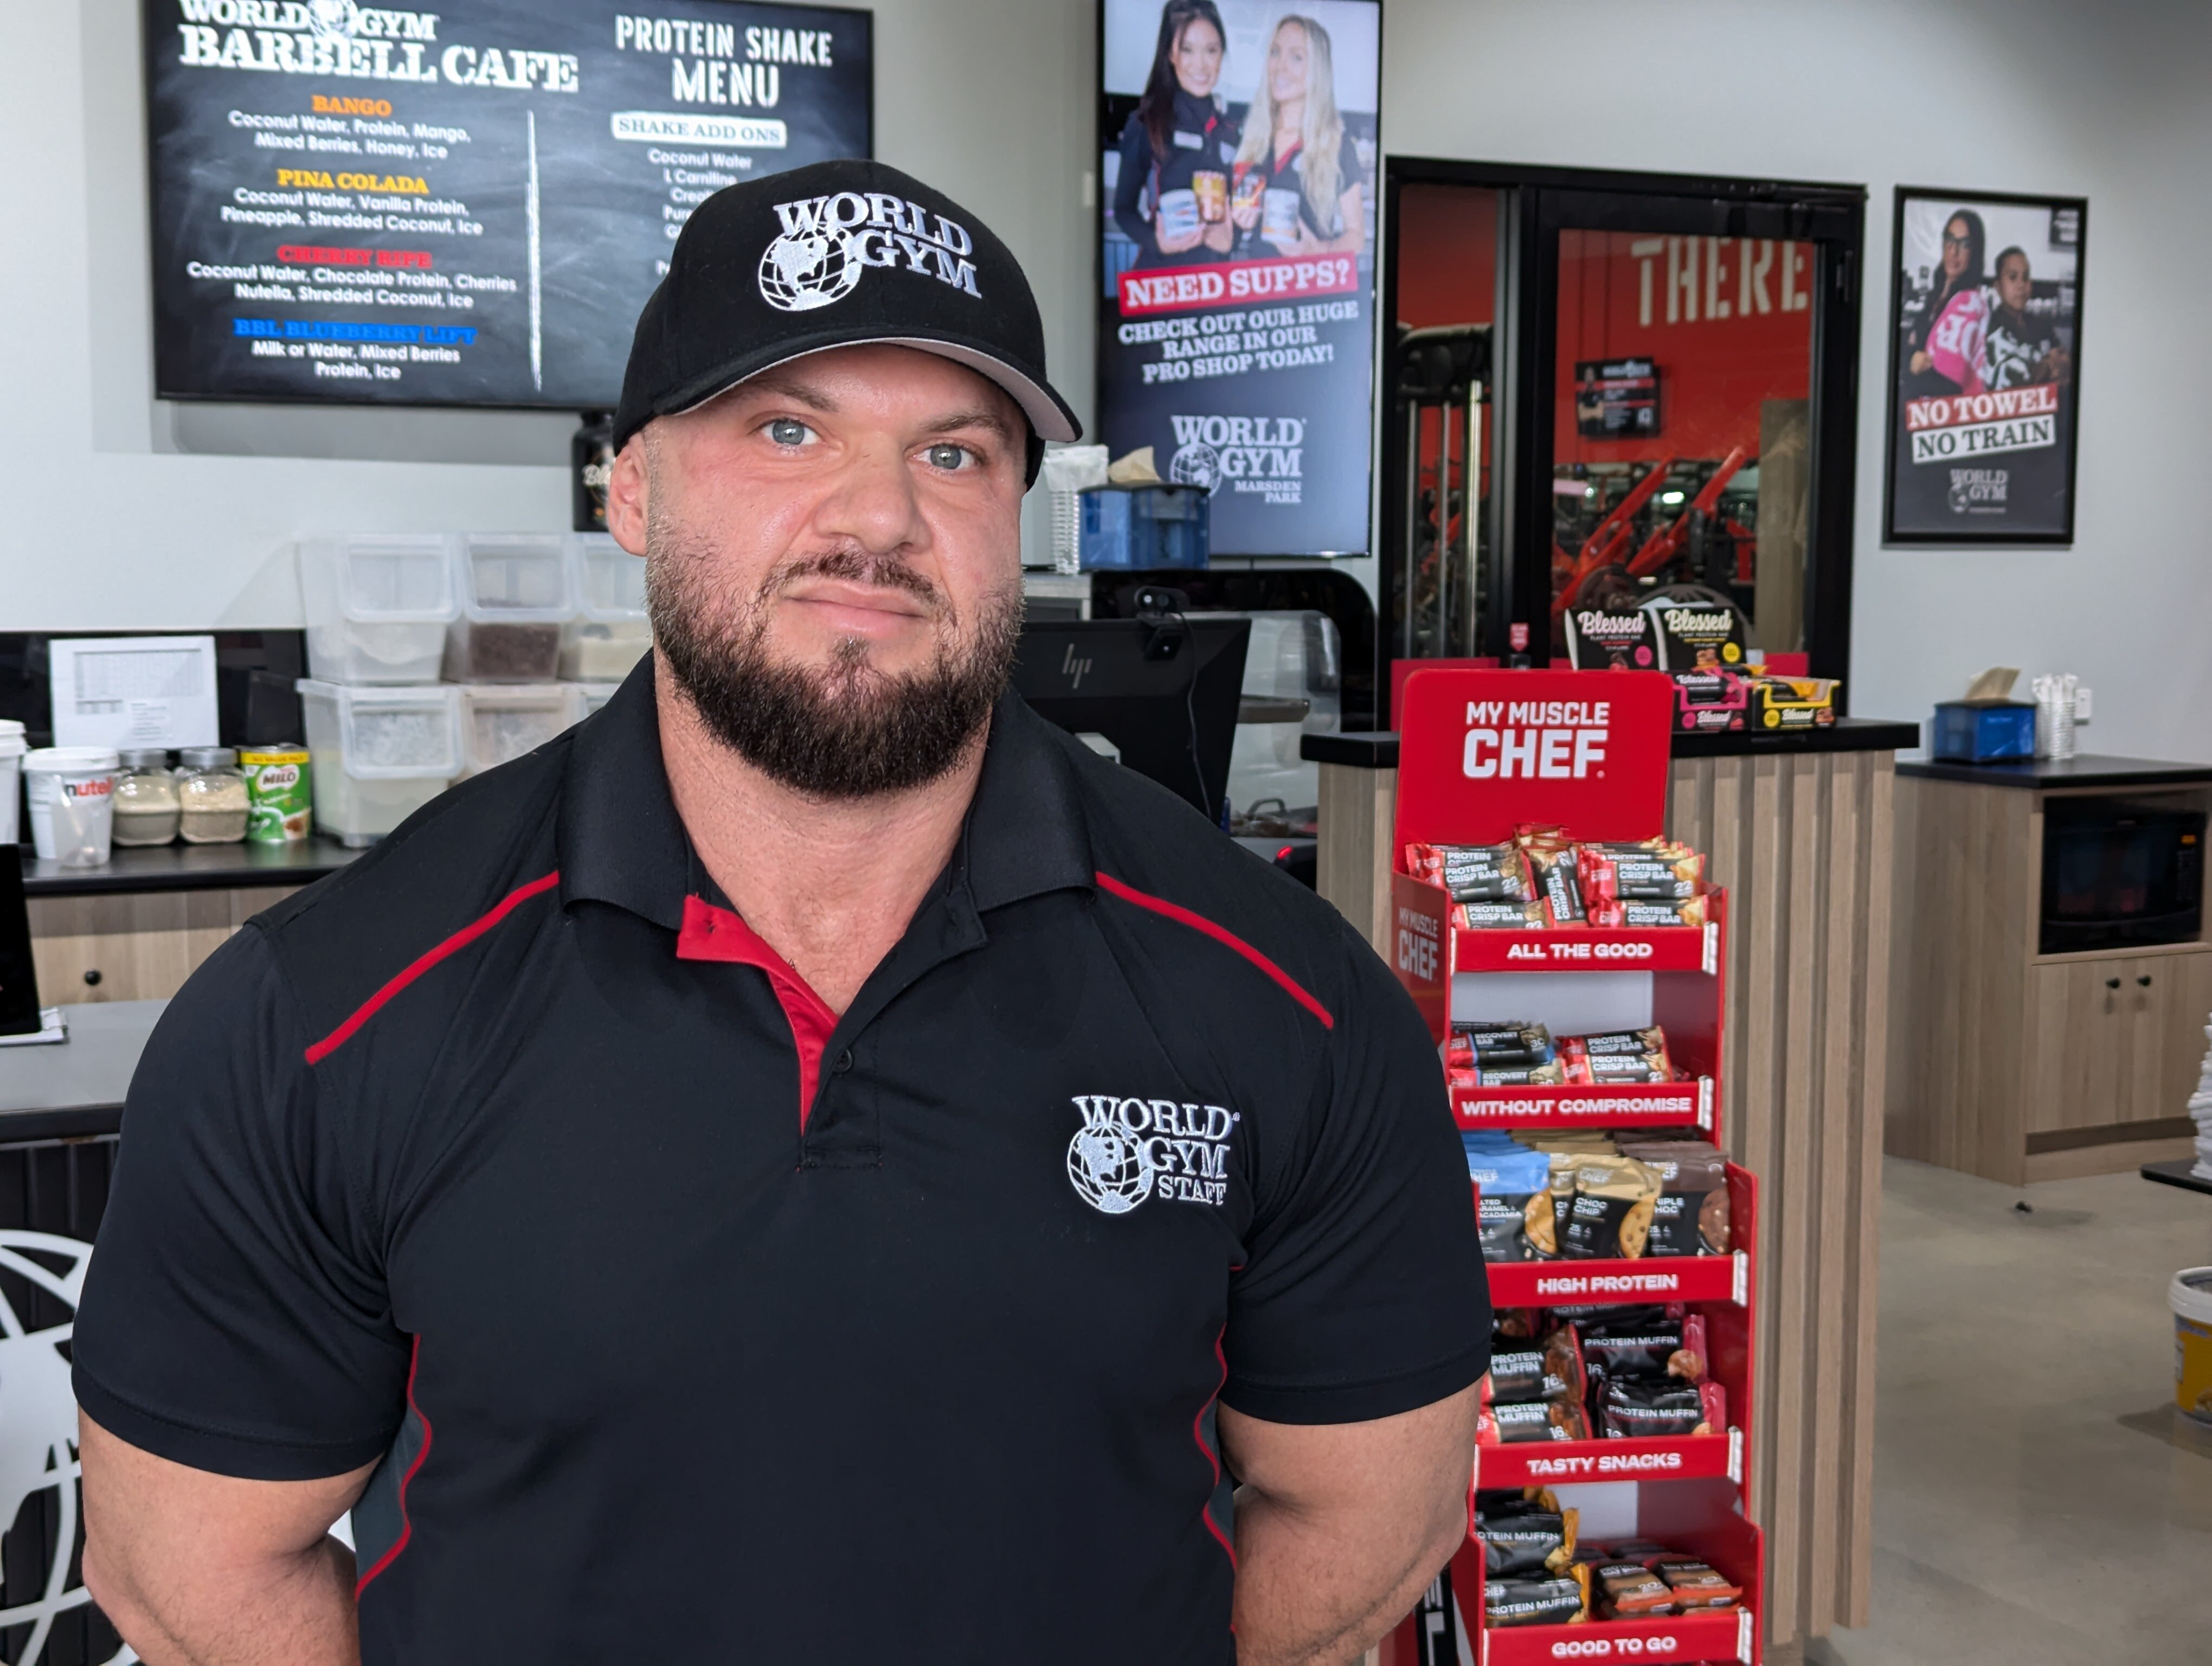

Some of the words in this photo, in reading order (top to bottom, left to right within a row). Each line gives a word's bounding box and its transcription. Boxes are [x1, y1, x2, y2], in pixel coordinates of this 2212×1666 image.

[178, 0, 311, 29] WORLD
[357, 7, 438, 41] GYM
[615, 15, 734, 58] PROTEIN
[745, 26, 832, 67] SHAKE
[178, 24, 438, 82] BARBELL
[441, 44, 578, 93] CAFE
[672, 58, 779, 107] MENU
[312, 94, 392, 117] BANGO
[228, 110, 298, 130] Coconut
[619, 118, 689, 136] SHAKE
[694, 123, 736, 139] ADD
[741, 126, 781, 142] ONS
[254, 131, 305, 150] Mixed
[421, 142, 448, 160] Ice
[647, 148, 709, 166] Coconut
[710, 151, 752, 169] Water
[276, 168, 336, 188] PINA
[336, 172, 430, 195] COLADA
[673, 168, 737, 185] Carnitine
[233, 187, 304, 207] Coconut
[358, 194, 411, 213] Vanilla
[307, 210, 383, 230] Shredded
[456, 219, 484, 235] Ice
[773, 191, 973, 256] WORLD
[276, 245, 373, 266] CHERRY
[376, 249, 432, 269] RIPE
[853, 229, 982, 299] GYM
[187, 261, 258, 279] Coconut
[312, 267, 395, 286] Chocolate
[454, 273, 517, 292] Cherries
[1125, 271, 1225, 307] NEED
[1229, 258, 1351, 297] SUPPS?
[1631, 235, 1808, 328] THERE
[298, 285, 373, 304] Shredded
[447, 292, 474, 309] Ice
[232, 318, 282, 338] BBL
[283, 319, 422, 344] BLUEBERRY
[423, 326, 478, 345] LIFT
[1118, 317, 1199, 345] CHECK
[1200, 312, 1246, 334] OUT
[1249, 307, 1295, 329] OUR
[1297, 299, 1359, 324] HUGE
[252, 340, 286, 357] Milk
[287, 344, 305, 358] or
[358, 343, 408, 361] Mixed
[409, 345, 460, 363] Berries
[1162, 334, 1240, 360] RANGE
[1243, 330, 1268, 350] IN
[1271, 325, 1317, 348] OUR
[374, 363, 402, 380] Ice
[1142, 360, 1191, 384] PRO
[1192, 353, 1253, 379] SHOP
[1255, 343, 1334, 370] TODAY!
[1908, 399, 1950, 427] NO
[1953, 386, 2057, 422] TOWEL
[1171, 415, 1303, 446] WORLD
[1917, 432, 1956, 458] NO
[1962, 419, 2049, 451] TRAIN
[1220, 446, 1303, 478] GYM
[1234, 480, 1301, 492] MARSDEN
[1950, 468, 2007, 484] WORLD
[1264, 491, 1301, 503] PARK
[1969, 484, 2007, 500] GYM
[1577, 610, 1646, 635] Blessed
[1664, 608, 1733, 632] Blessed
[1466, 701, 1504, 725] MY
[1508, 701, 1610, 726] MUSCLE
[1447, 852, 1491, 861] PROTEIN
[1619, 863, 1664, 871] PROTEIN
[1445, 863, 1488, 875] PROTEIN
[1446, 872, 1477, 883] CRISP
[1478, 869, 1500, 880] BAR
[1619, 871, 1651, 879] CRISP
[1652, 871, 1674, 879] BAR
[1468, 905, 1512, 913] PROTEIN
[1546, 877, 1563, 920] PROTEIN
[1469, 913, 1501, 921] CRISP
[1502, 913, 1523, 921] BAR
[1628, 906, 1672, 914] PROTEIN
[1628, 914, 1658, 922] CRISP
[1660, 914, 1681, 922] BAR
[1399, 928, 1438, 981] CHEF
[1507, 944, 1546, 959] ALL
[1549, 944, 1591, 958] THE
[1594, 943, 1653, 958] GOOD
[1587, 1035, 1631, 1046] PROTEIN
[1589, 1043, 1619, 1054] CRISP
[1621, 1041, 1643, 1050] BAR
[1482, 1072, 1528, 1080] RECOVERY
[1462, 1100, 1554, 1116] WITHOUT
[1559, 1097, 1692, 1114] COMPROMISE
[1143, 1136, 1230, 1179] GYM
[1471, 1172, 1499, 1182] HEF
[1158, 1174, 1227, 1206] STAFF
[1573, 1205, 1600, 1216] CHIP
[1575, 1197, 1607, 1209] CHOC
[1656, 1197, 1684, 1206] RIPLE
[1537, 1277, 1587, 1295] HIGH
[1590, 1274, 1679, 1292] PROTEIN
[1584, 1337, 1636, 1346] PROTEIN
[1638, 1336, 1679, 1345] MUFFIN
[1491, 1352, 1544, 1365] PROTEIN
[1492, 1362, 1541, 1375] MUFFIN
[1495, 1403, 1549, 1413] PROTEIN
[1497, 1411, 1546, 1424] MUFFIN
[1607, 1405, 1657, 1417] PROTEIN
[1659, 1408, 1698, 1418] MUFFIN
[1527, 1457, 1593, 1475] TASTY
[1598, 1452, 1682, 1472] SNACKS
[1514, 1532, 1561, 1541] MUFFIN
[1486, 1601, 1534, 1614] PROTEIN
[1536, 1595, 1581, 1609] MUFFIN
[1552, 1639, 1610, 1657] GOOD
[1615, 1638, 1643, 1654] TO
[1647, 1636, 1677, 1652] GO
